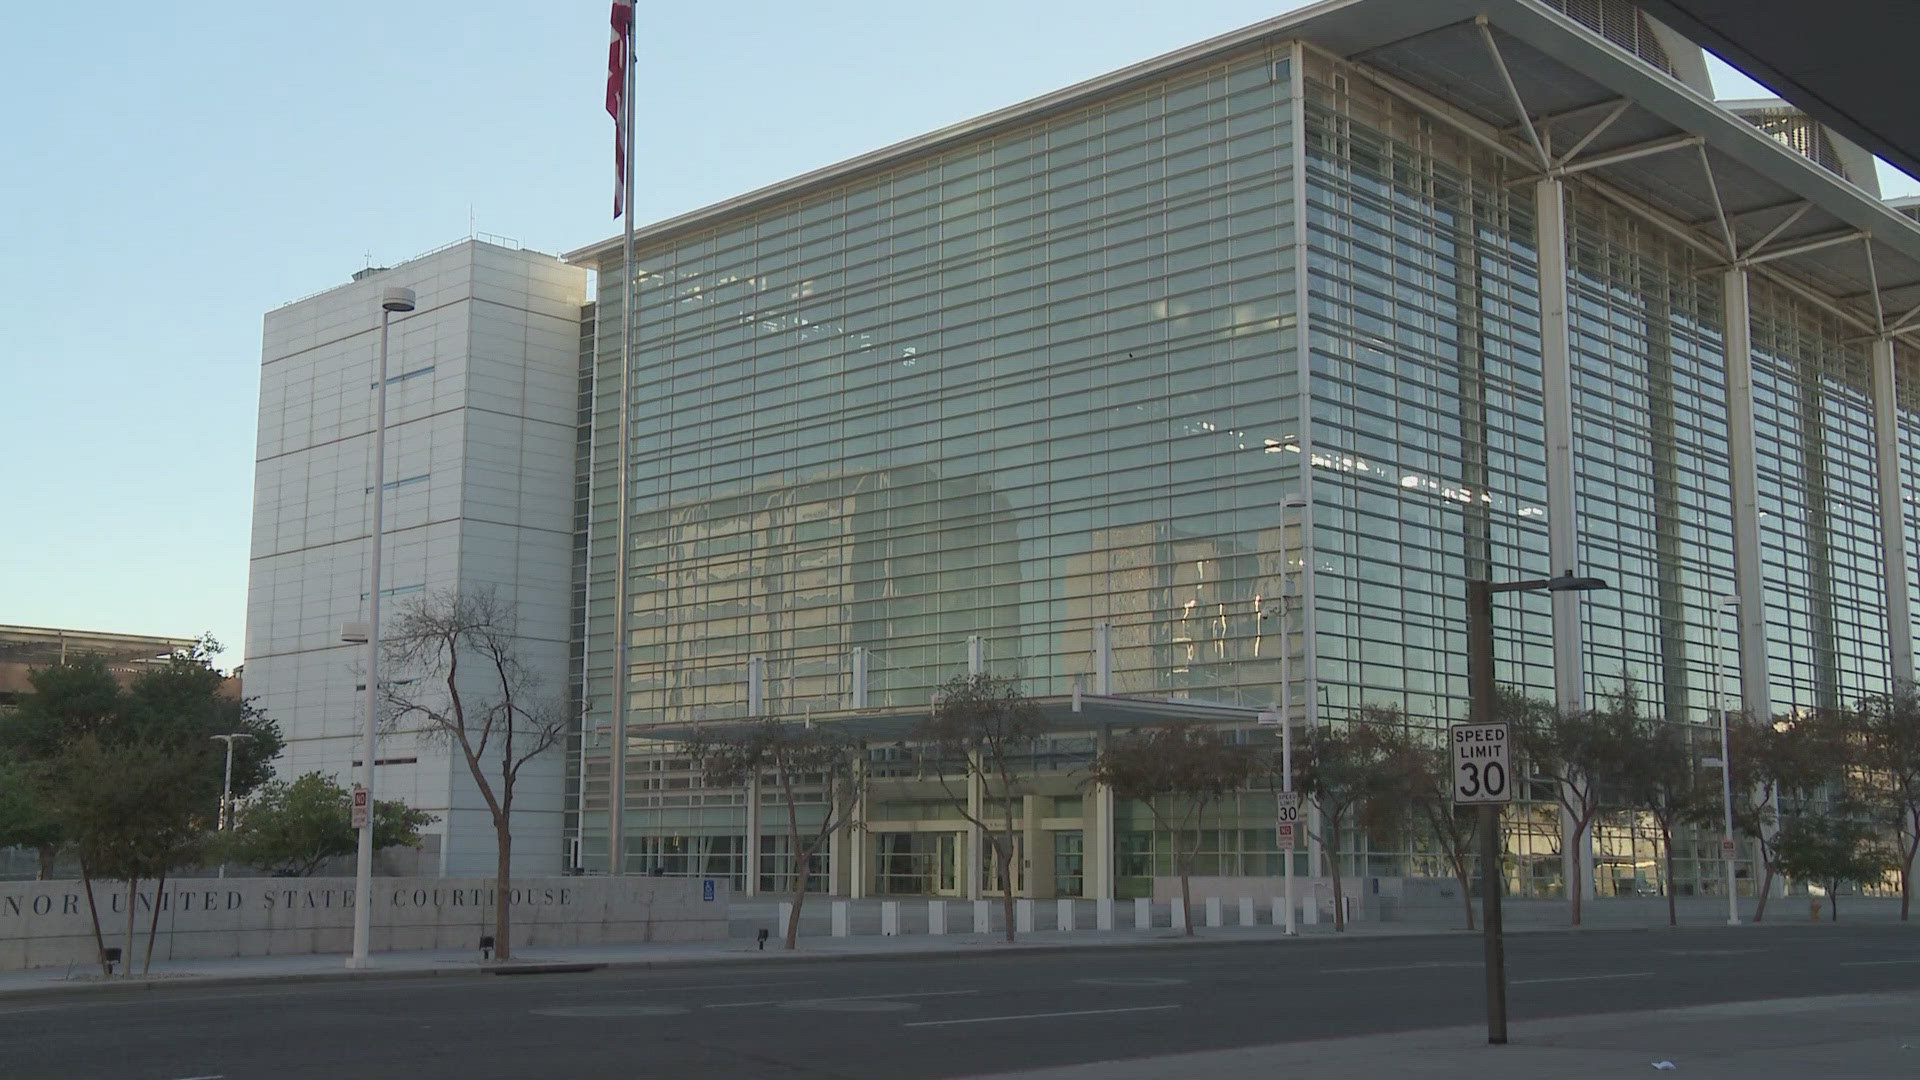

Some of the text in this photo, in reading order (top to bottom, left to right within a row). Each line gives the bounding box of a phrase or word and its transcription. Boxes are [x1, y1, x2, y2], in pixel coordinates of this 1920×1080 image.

[1456, 729, 1504, 742] SPEED
[1461, 745, 1501, 758] LIMIT
[1460, 761, 1504, 797] 30
[356, 793, 365, 804] NO
[1280, 806, 1297, 821] 30
[1280, 826, 1291, 835] NO
[3, 894, 79, 917] NOR
[112, 891, 243, 914] UNITED
[263, 889, 373, 911] STATE
